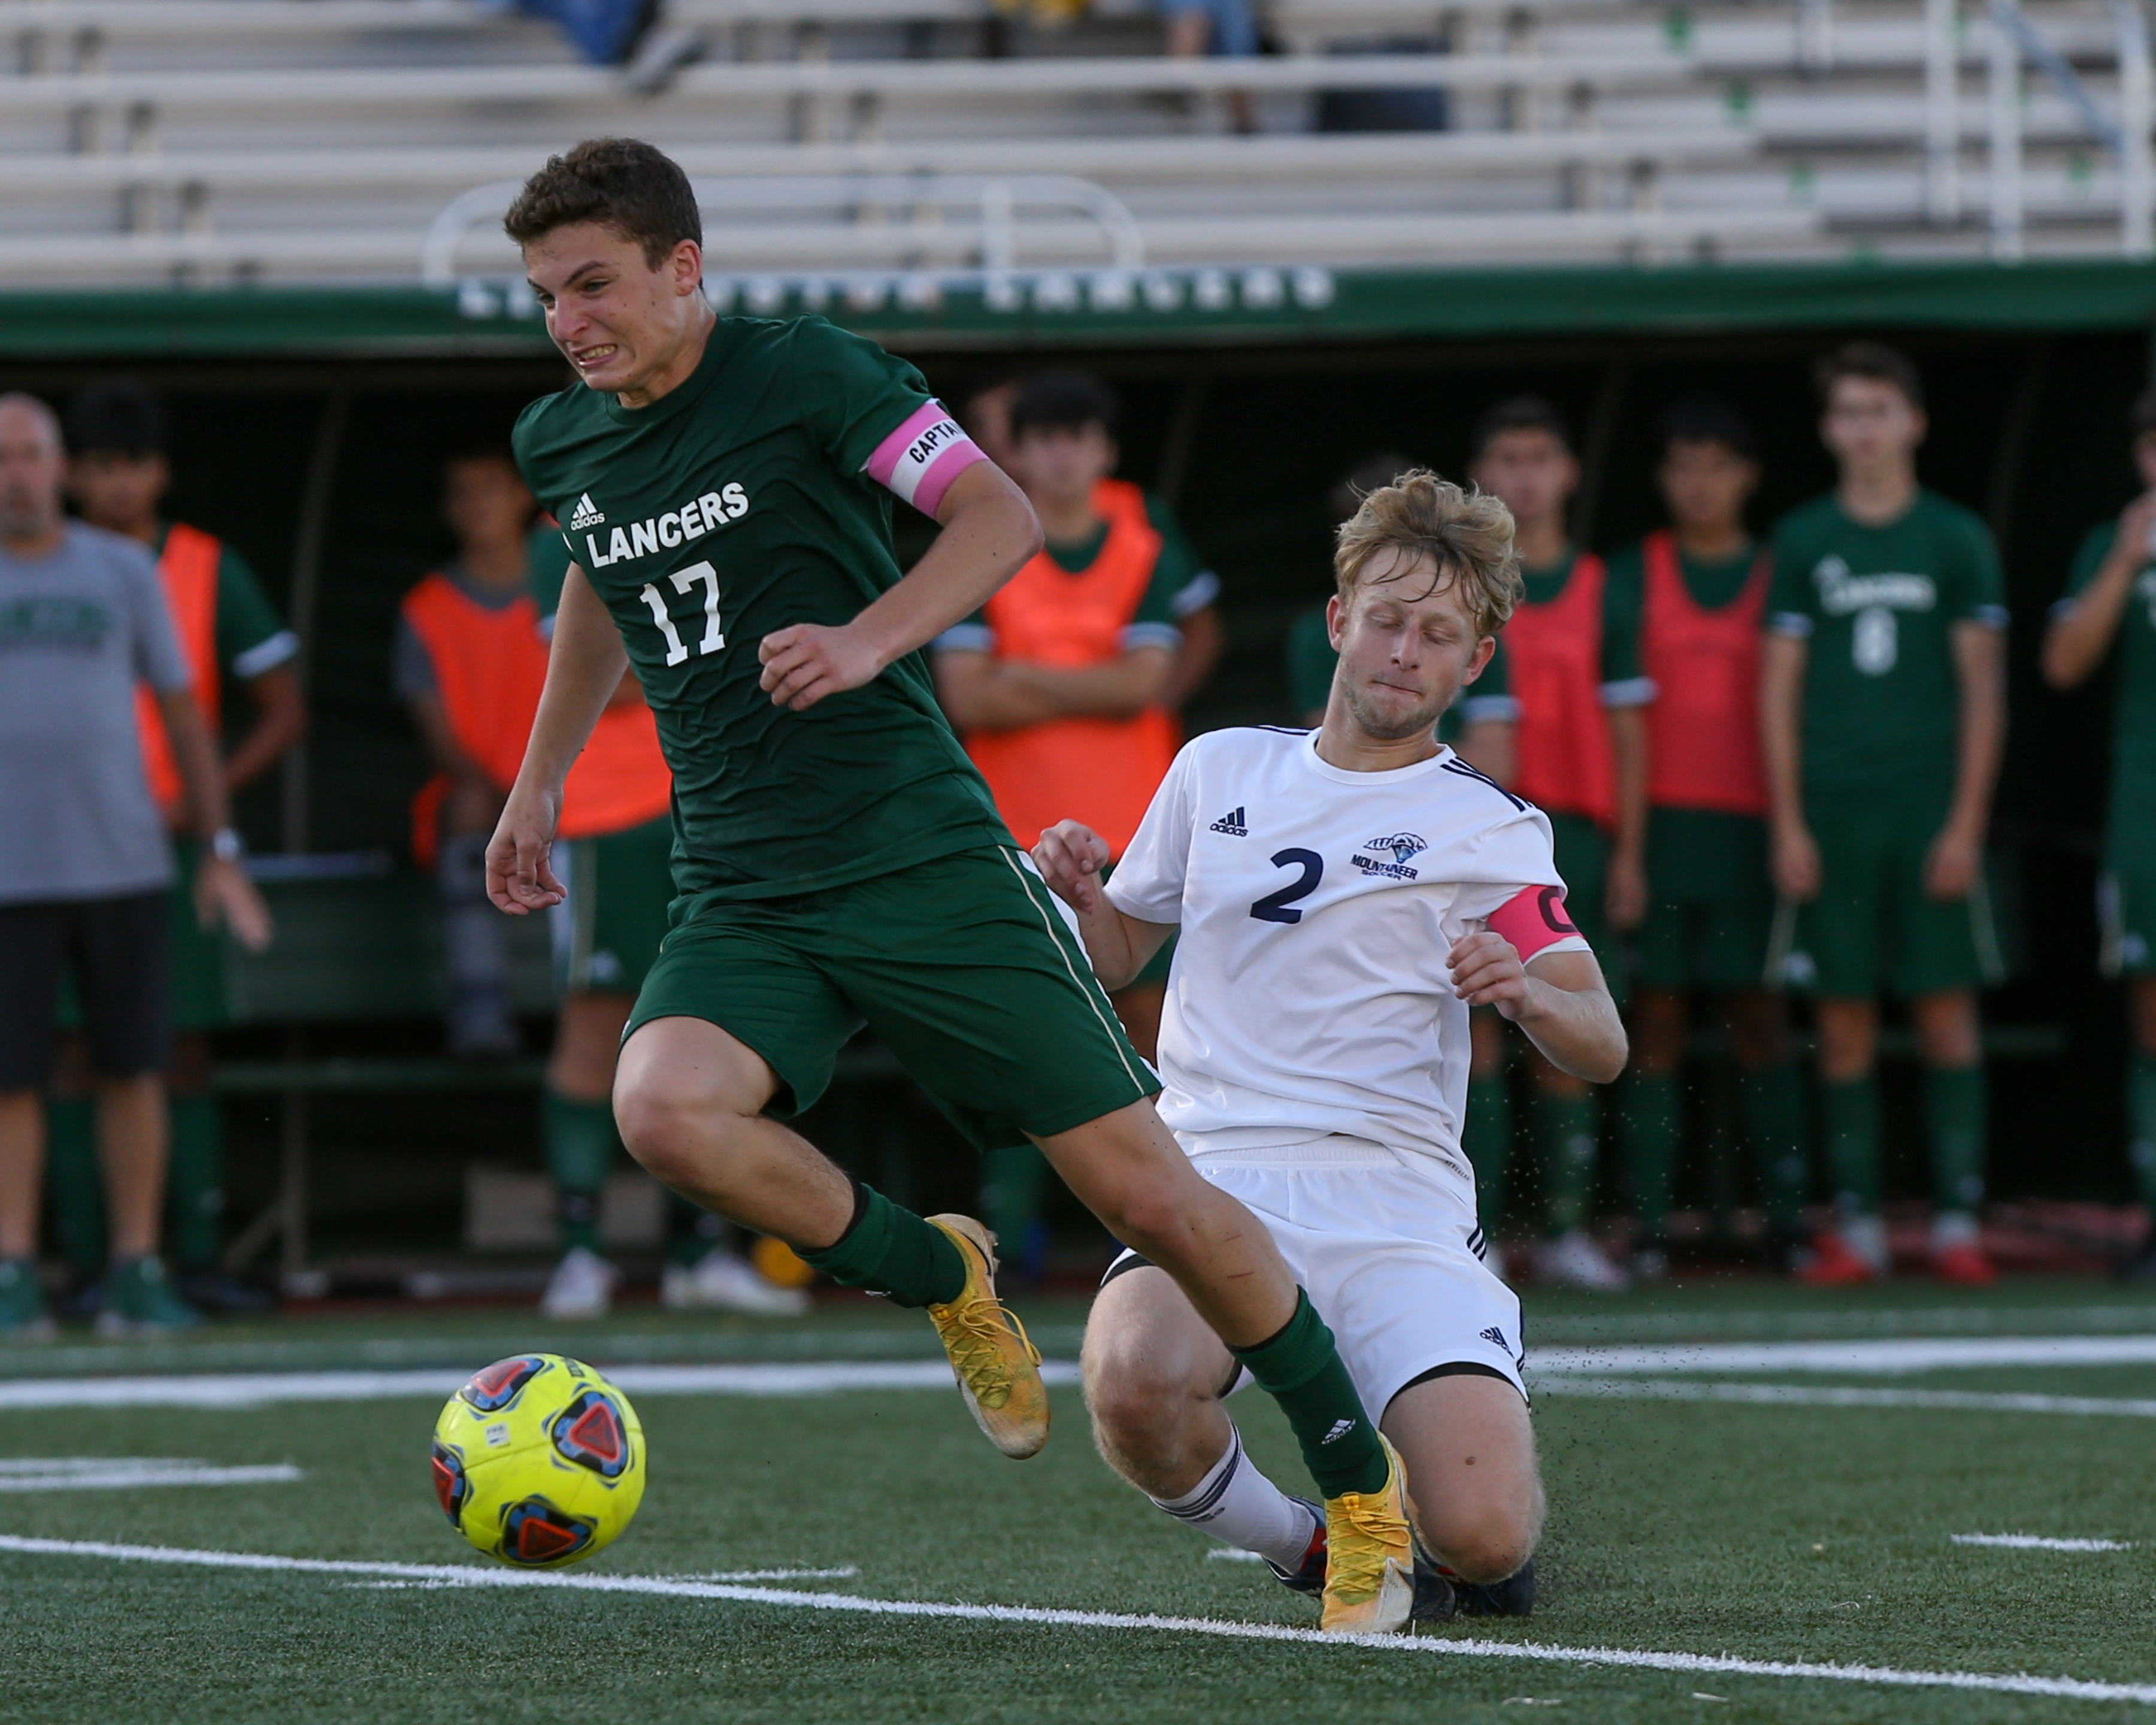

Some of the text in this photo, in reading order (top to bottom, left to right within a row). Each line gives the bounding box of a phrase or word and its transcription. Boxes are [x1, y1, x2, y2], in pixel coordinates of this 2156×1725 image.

[570, 512, 606, 531] adidas
[586, 482, 749, 568] LANCERS
[638, 559, 726, 667] 17
[1209, 822, 1249, 837] adidas
[1249, 847, 1324, 925] 2
[1537, 886, 1579, 933] C
